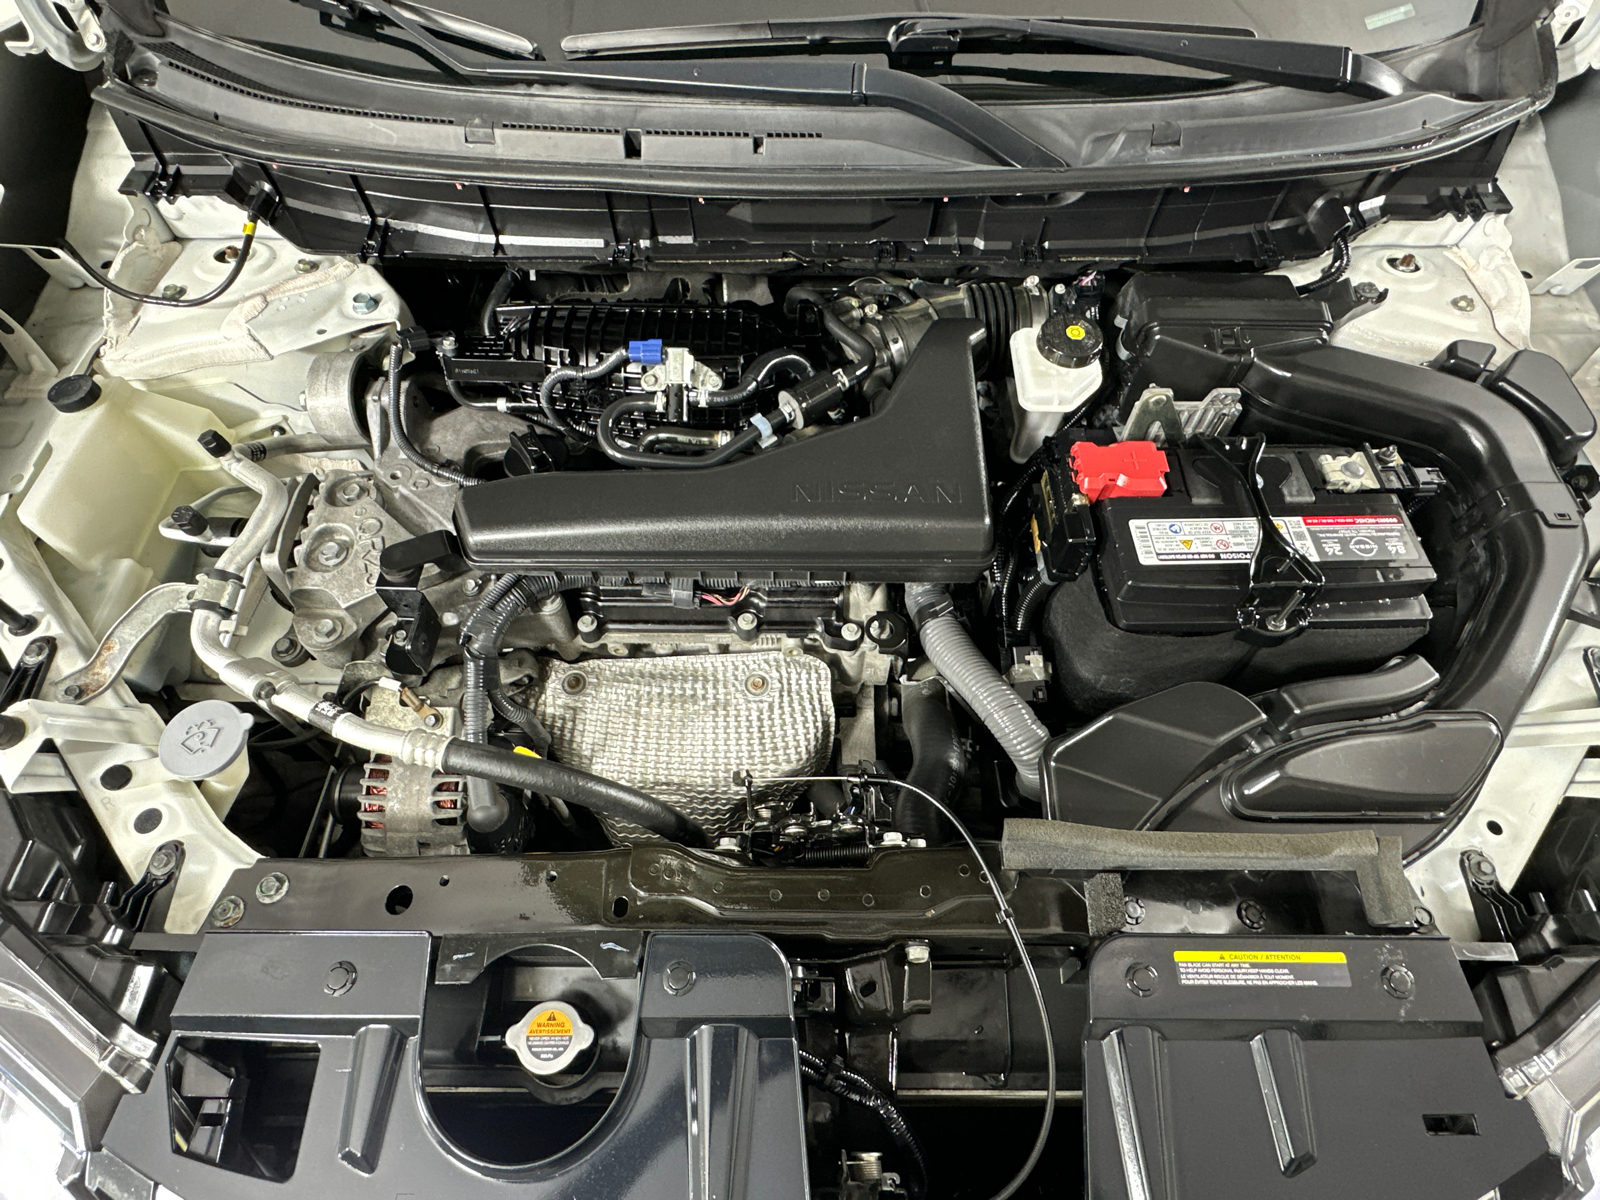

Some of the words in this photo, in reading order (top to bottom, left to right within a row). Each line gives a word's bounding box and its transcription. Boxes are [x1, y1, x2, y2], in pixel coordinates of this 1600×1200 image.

[790, 480, 962, 504] NISSAN
[1324, 547, 1343, 556] 24
[1387, 545, 1406, 555] 84
[101, 796, 115, 810] R
